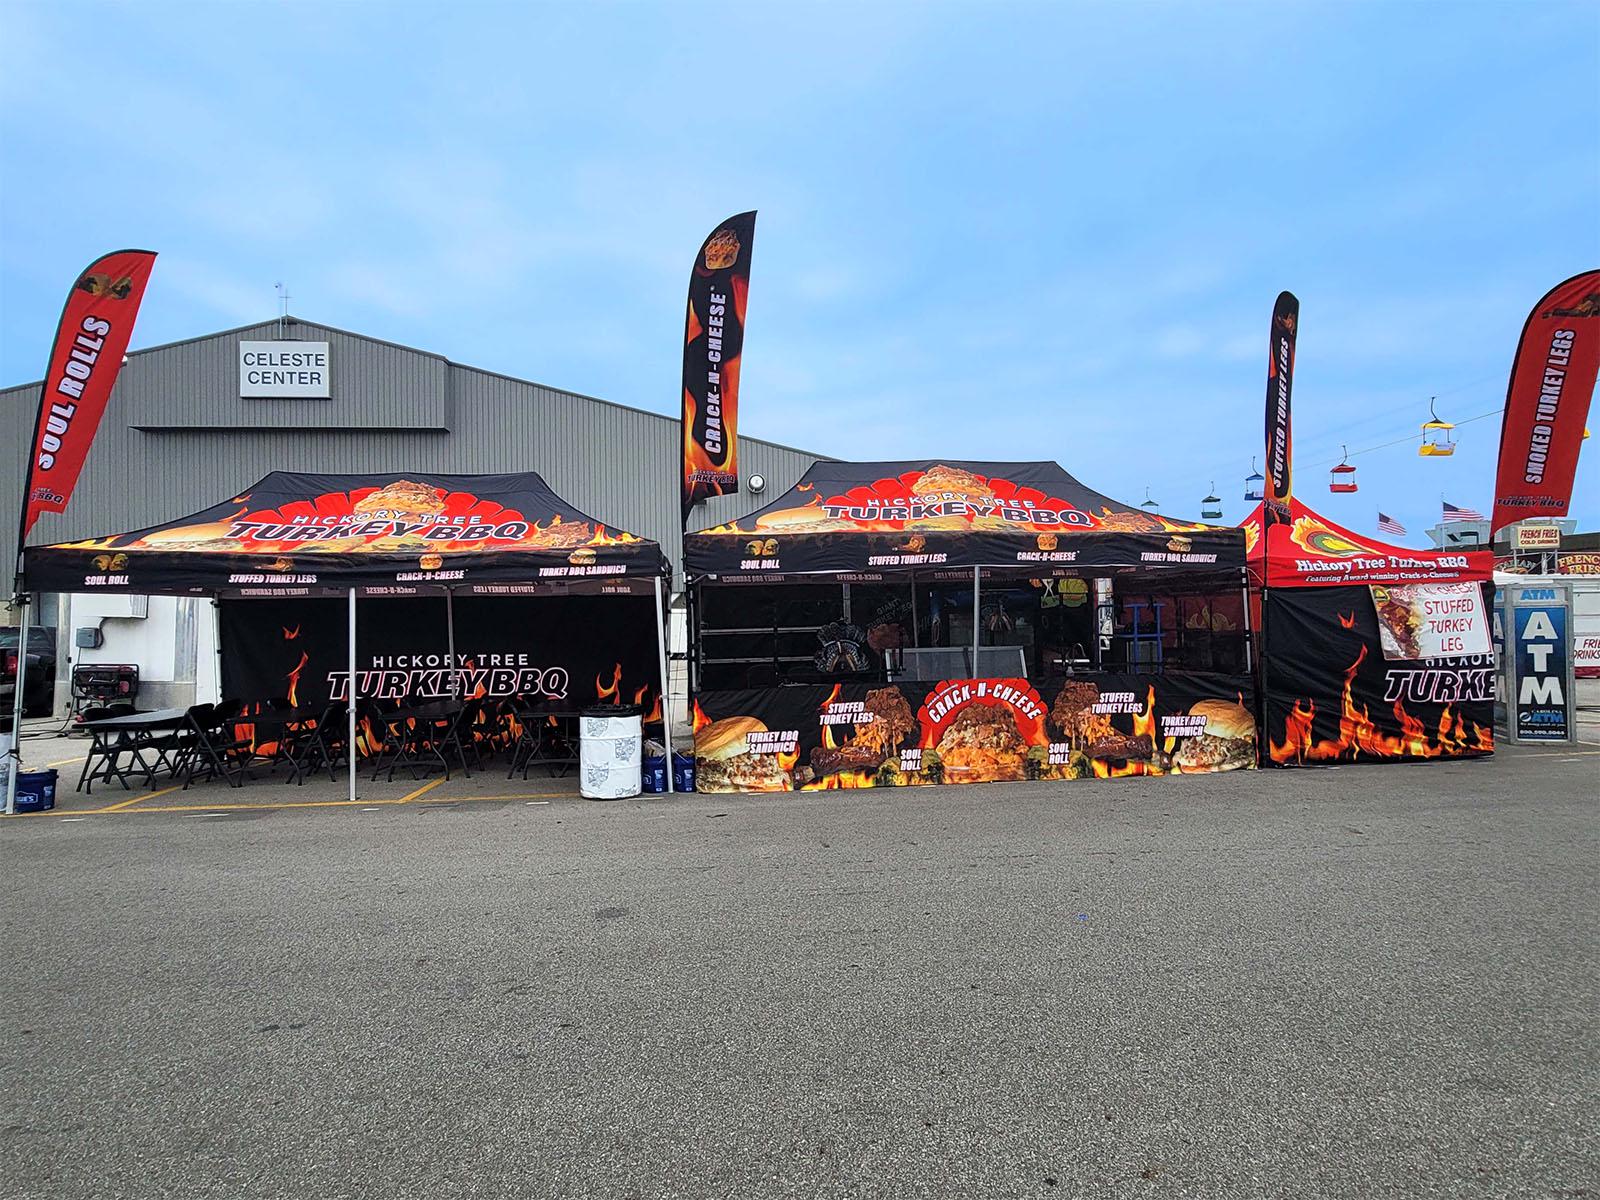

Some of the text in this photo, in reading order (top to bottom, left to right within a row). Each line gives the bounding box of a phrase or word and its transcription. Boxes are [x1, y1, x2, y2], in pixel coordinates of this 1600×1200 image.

[243, 352, 326, 367] CELESTE
[1280, 337, 1290, 374] LEGS
[247, 371, 322, 385] CENTER
[705, 293, 726, 454] CRACK-N-CHEESE
[38, 315, 111, 471] SOUL ROLLS
[1277, 374, 1290, 427] TURKEY
[1525, 329, 1575, 484] SMOKED TURKEY LEGS
[1274, 428, 1288, 488] STUFFED
[867, 492, 1036, 509] HICKORY TREE
[292, 509, 482, 525] HICKORY TREE
[821, 501, 1095, 528] TURKEY BBQ
[223, 520, 529, 542] TURKEY BBQ
[868, 553, 948, 566] STUFFED TURKEY LEGS
[1016, 551, 1077, 561] CRACK-N-CHEESE
[1140, 552, 1217, 563] TURKEY BBQ SANDWICH
[740, 559, 780, 570] SOUL ROLL
[1295, 559, 1353, 573] Hickory
[1353, 557, 1386, 570] Tree
[1436, 555, 1470, 569] BBQ
[396, 570, 465, 581] CRACK-N-CHEESE
[538, 565, 627, 577] TURKEY BBQ SANDWICH
[1342, 573, 1369, 581] Award
[1370, 572, 1400, 581] winning
[84, 575, 130, 586] SOUL ROLL
[228, 574, 317, 584] STUFFED TURKEY LEGS
[1520, 589, 1556, 601] ATM
[1424, 598, 1474, 615] STUFFED
[1429, 618, 1473, 634] TURKEY
[1441, 637, 1464, 652] LEG
[372, 654, 529, 668] HICKORY TREE
[327, 666, 569, 700] TURKEY BBQ
[928, 682, 1042, 723] CRACK-N-CHEESE
[1099, 692, 1135, 703] STUFFED
[827, 701, 865, 714] STUFFED
[1091, 702, 1143, 714] TURKEY LEGS
[819, 711, 875, 726] TURKEY LEGS
[1160, 715, 1207, 727] TURKEY BBQ
[1531, 713, 1565, 723] ATM
[746, 730, 799, 743] TURKEY BBQ
[1163, 726, 1204, 737] SANDWICH
[750, 741, 797, 754] SANDWICH
[1048, 743, 1070, 754] SOUL
[900, 749, 922, 760] SOUL
[1048, 754, 1070, 764] ROLL
[900, 760, 922, 771] ROLL
